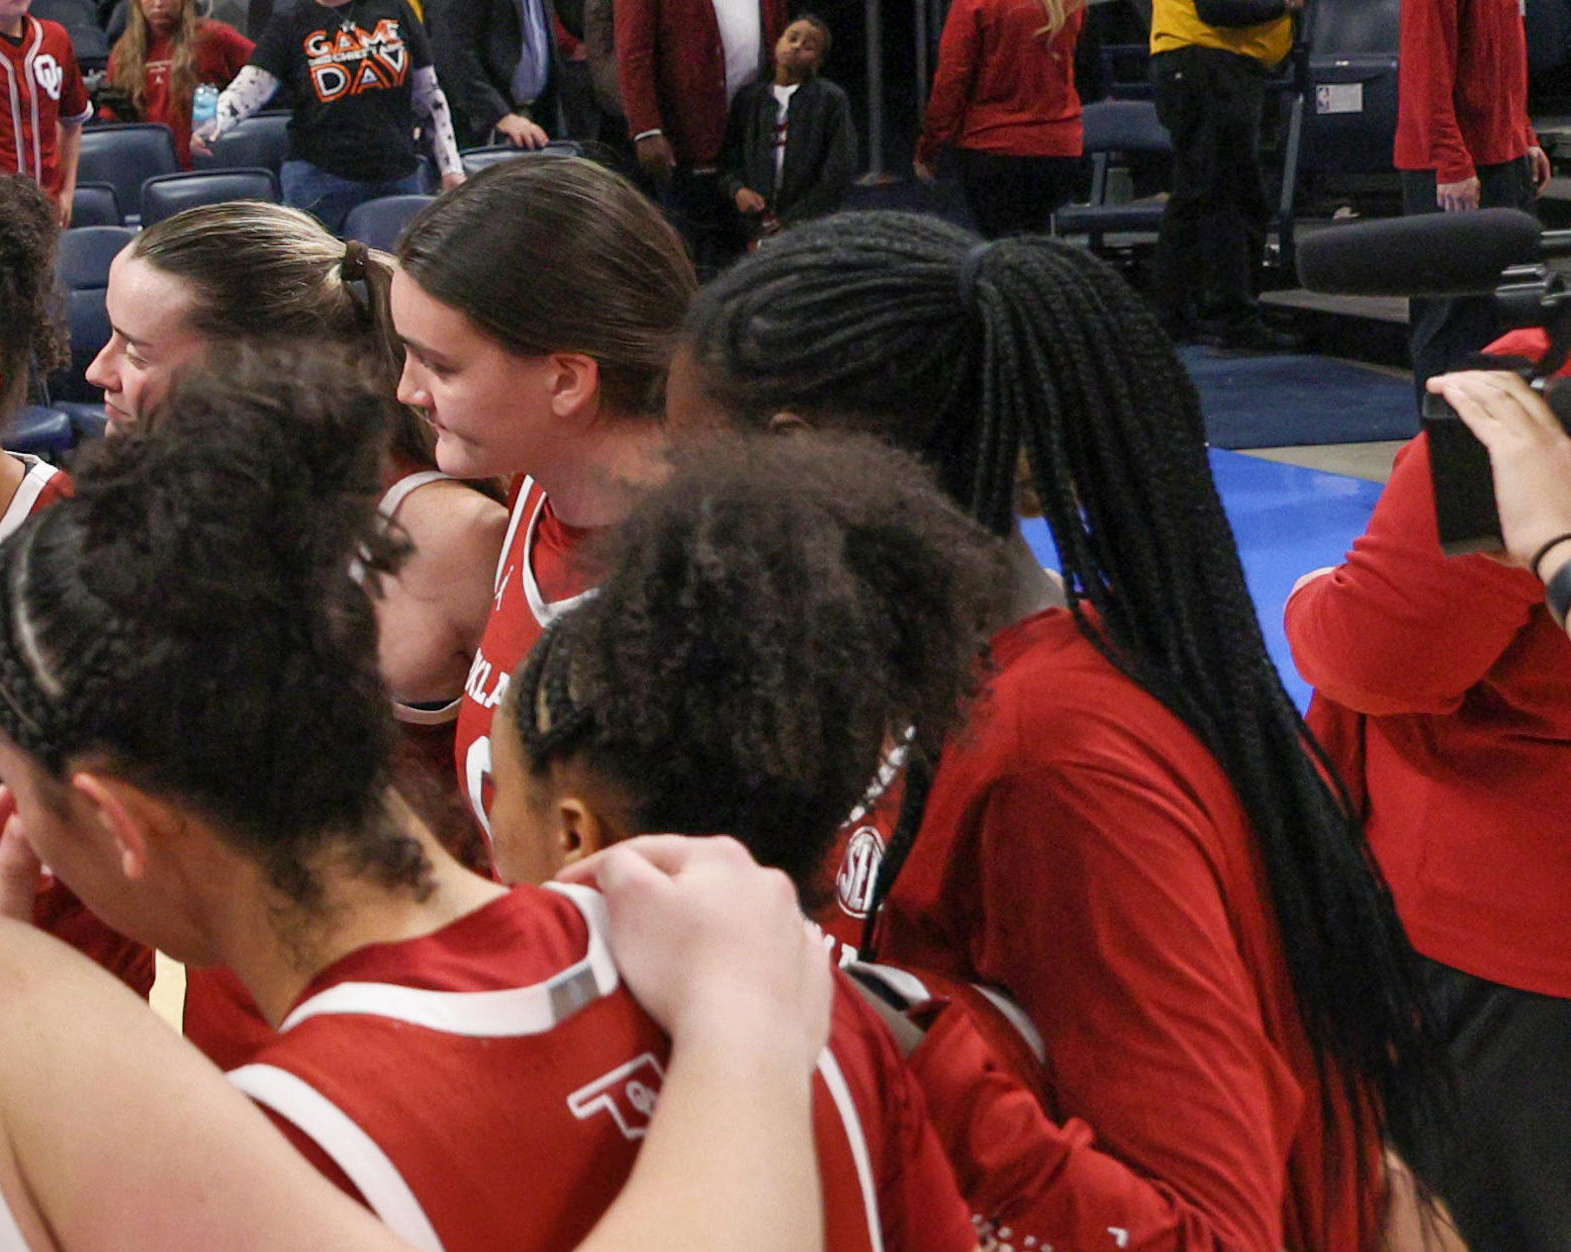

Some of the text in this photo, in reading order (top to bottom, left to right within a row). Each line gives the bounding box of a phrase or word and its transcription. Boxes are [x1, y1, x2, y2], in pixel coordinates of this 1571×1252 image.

[303, 20, 403, 58] GAME
[32, 54, 64, 100] OU
[309, 42, 410, 102] DAY
